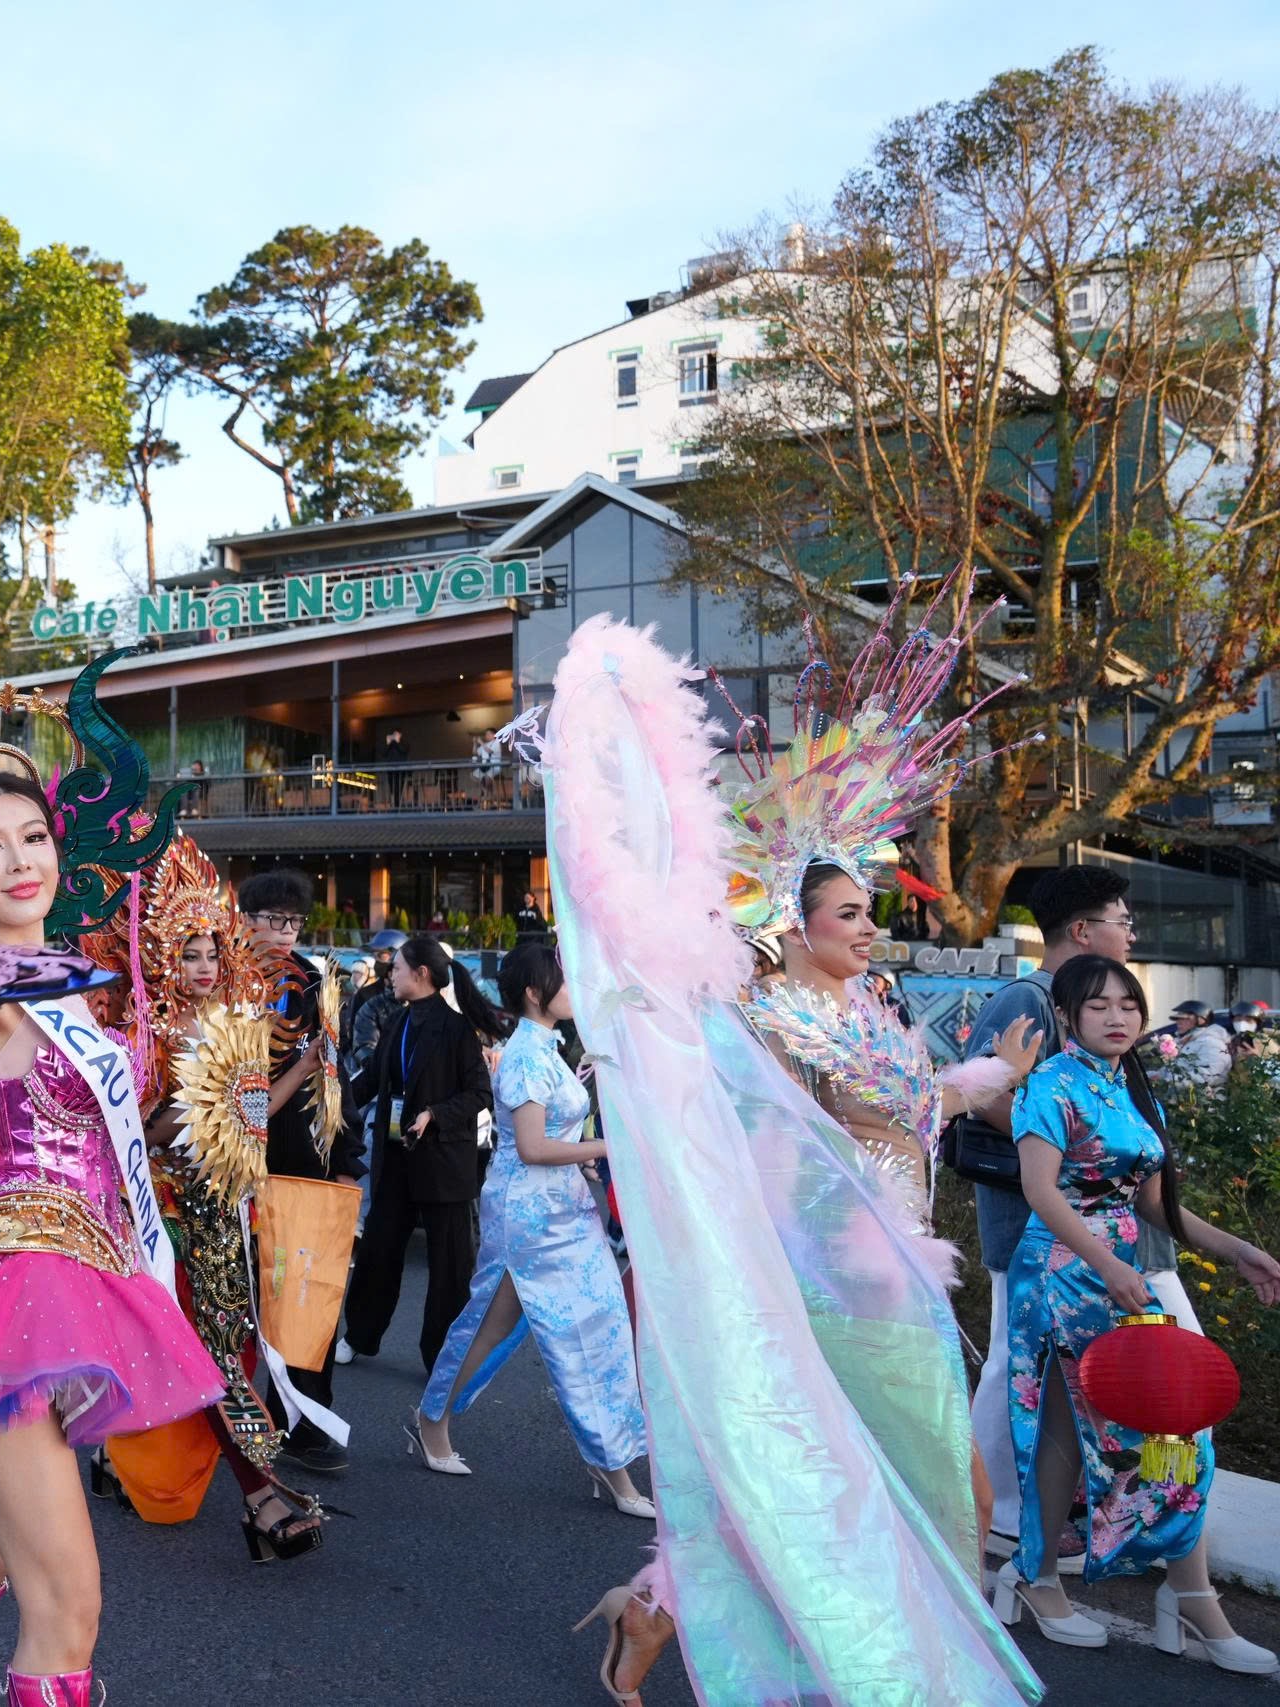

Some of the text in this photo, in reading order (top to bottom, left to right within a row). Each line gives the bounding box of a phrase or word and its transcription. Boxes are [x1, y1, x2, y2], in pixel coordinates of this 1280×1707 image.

[32, 599, 117, 640] Café
[26, 999, 130, 1107] ACAU
[127, 1137, 161, 1262] CHINA
